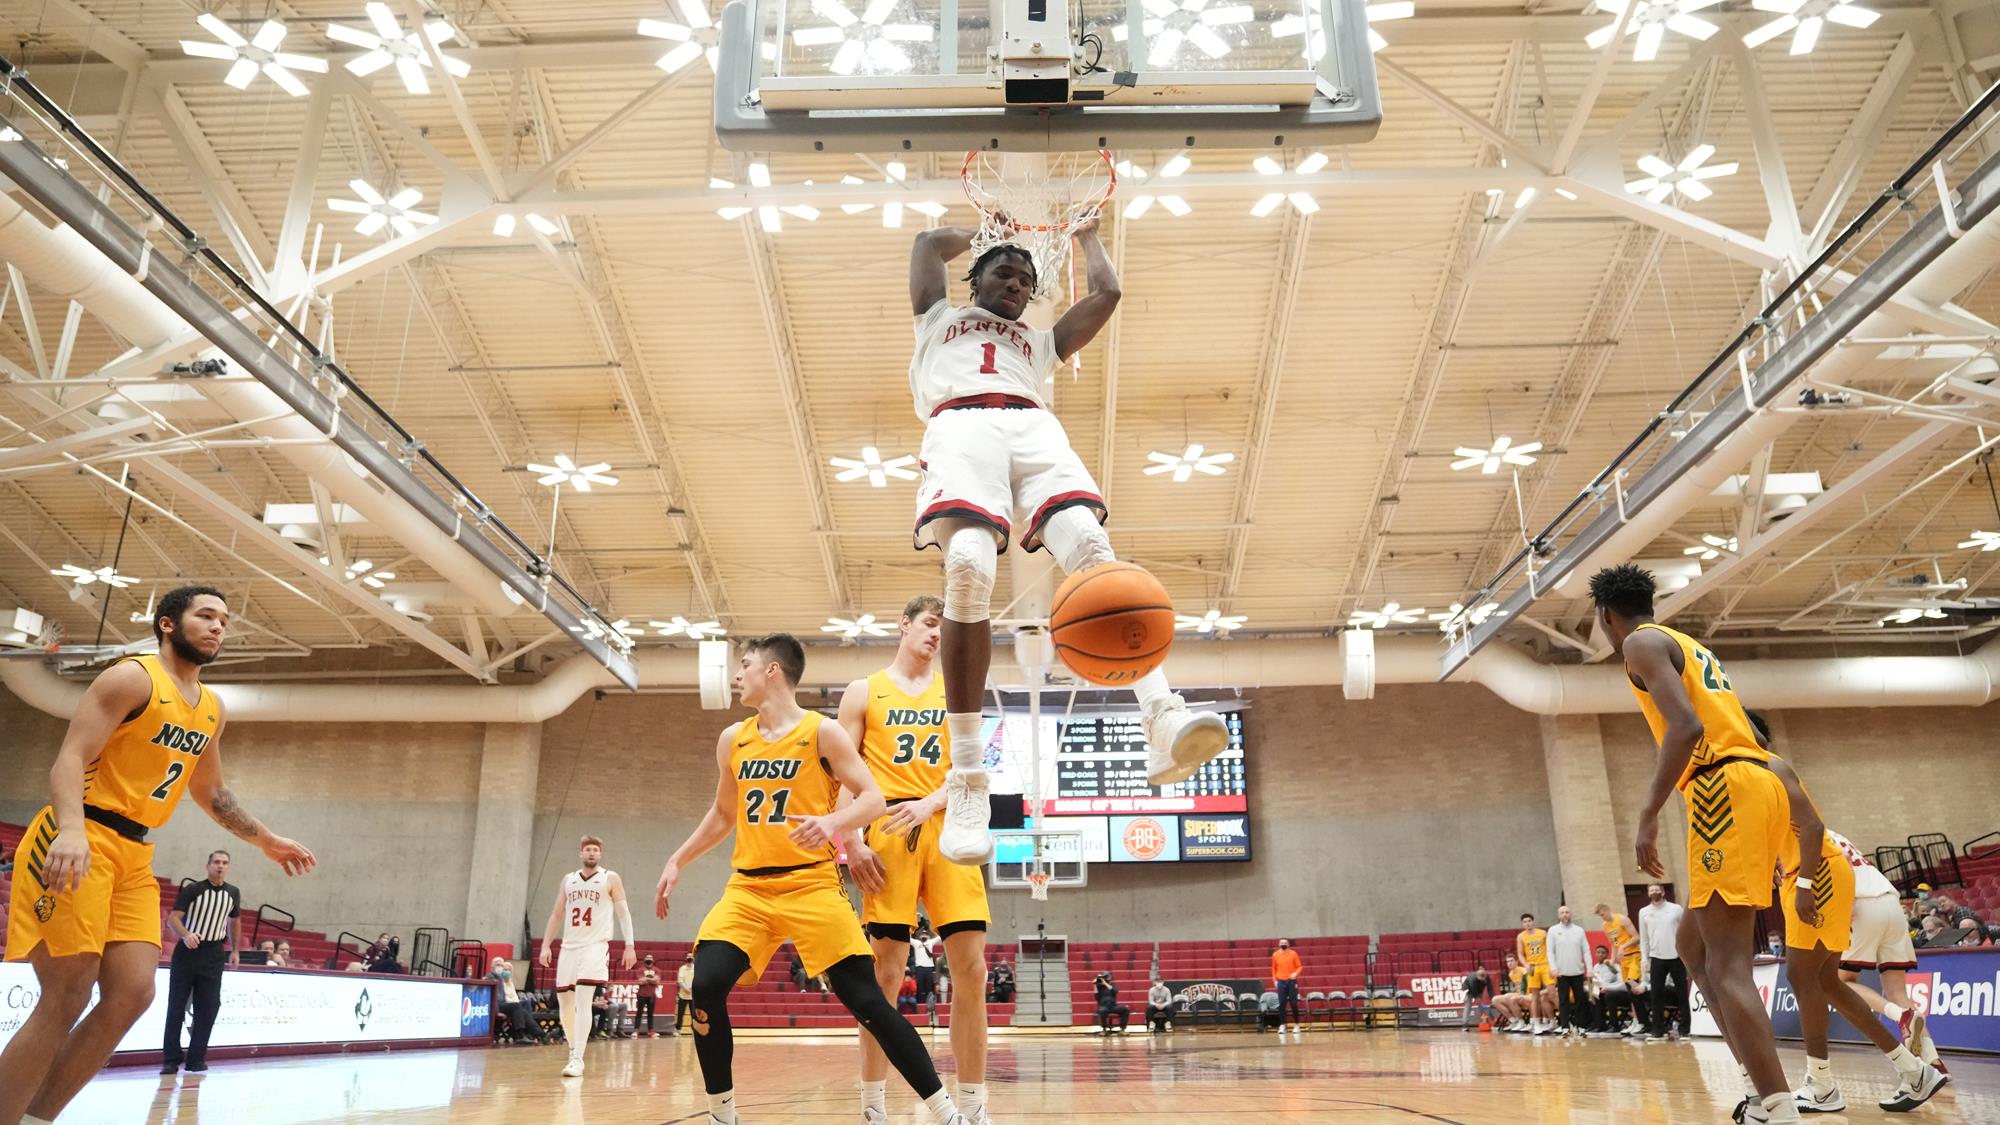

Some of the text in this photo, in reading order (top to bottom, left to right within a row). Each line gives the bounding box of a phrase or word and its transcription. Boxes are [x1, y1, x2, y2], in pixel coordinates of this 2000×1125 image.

[979, 341, 1000, 375] 1
[886, 708, 948, 727] NDSU
[151, 722, 210, 756] NDSU
[892, 732, 942, 766] 34
[737, 759, 802, 780] NDSU
[150, 762, 184, 801] 2
[746, 788, 790, 823] 21
[1184, 818, 1246, 837] SUPERBOOK
[1197, 836, 1232, 844] SPORTS
[568, 890, 601, 907] DENVER
[571, 907, 593, 927] 24
[1411, 976, 1466, 992] CRIMS
[1423, 990, 1467, 1005] CHAO
[471, 1003, 489, 1019] pepsi
